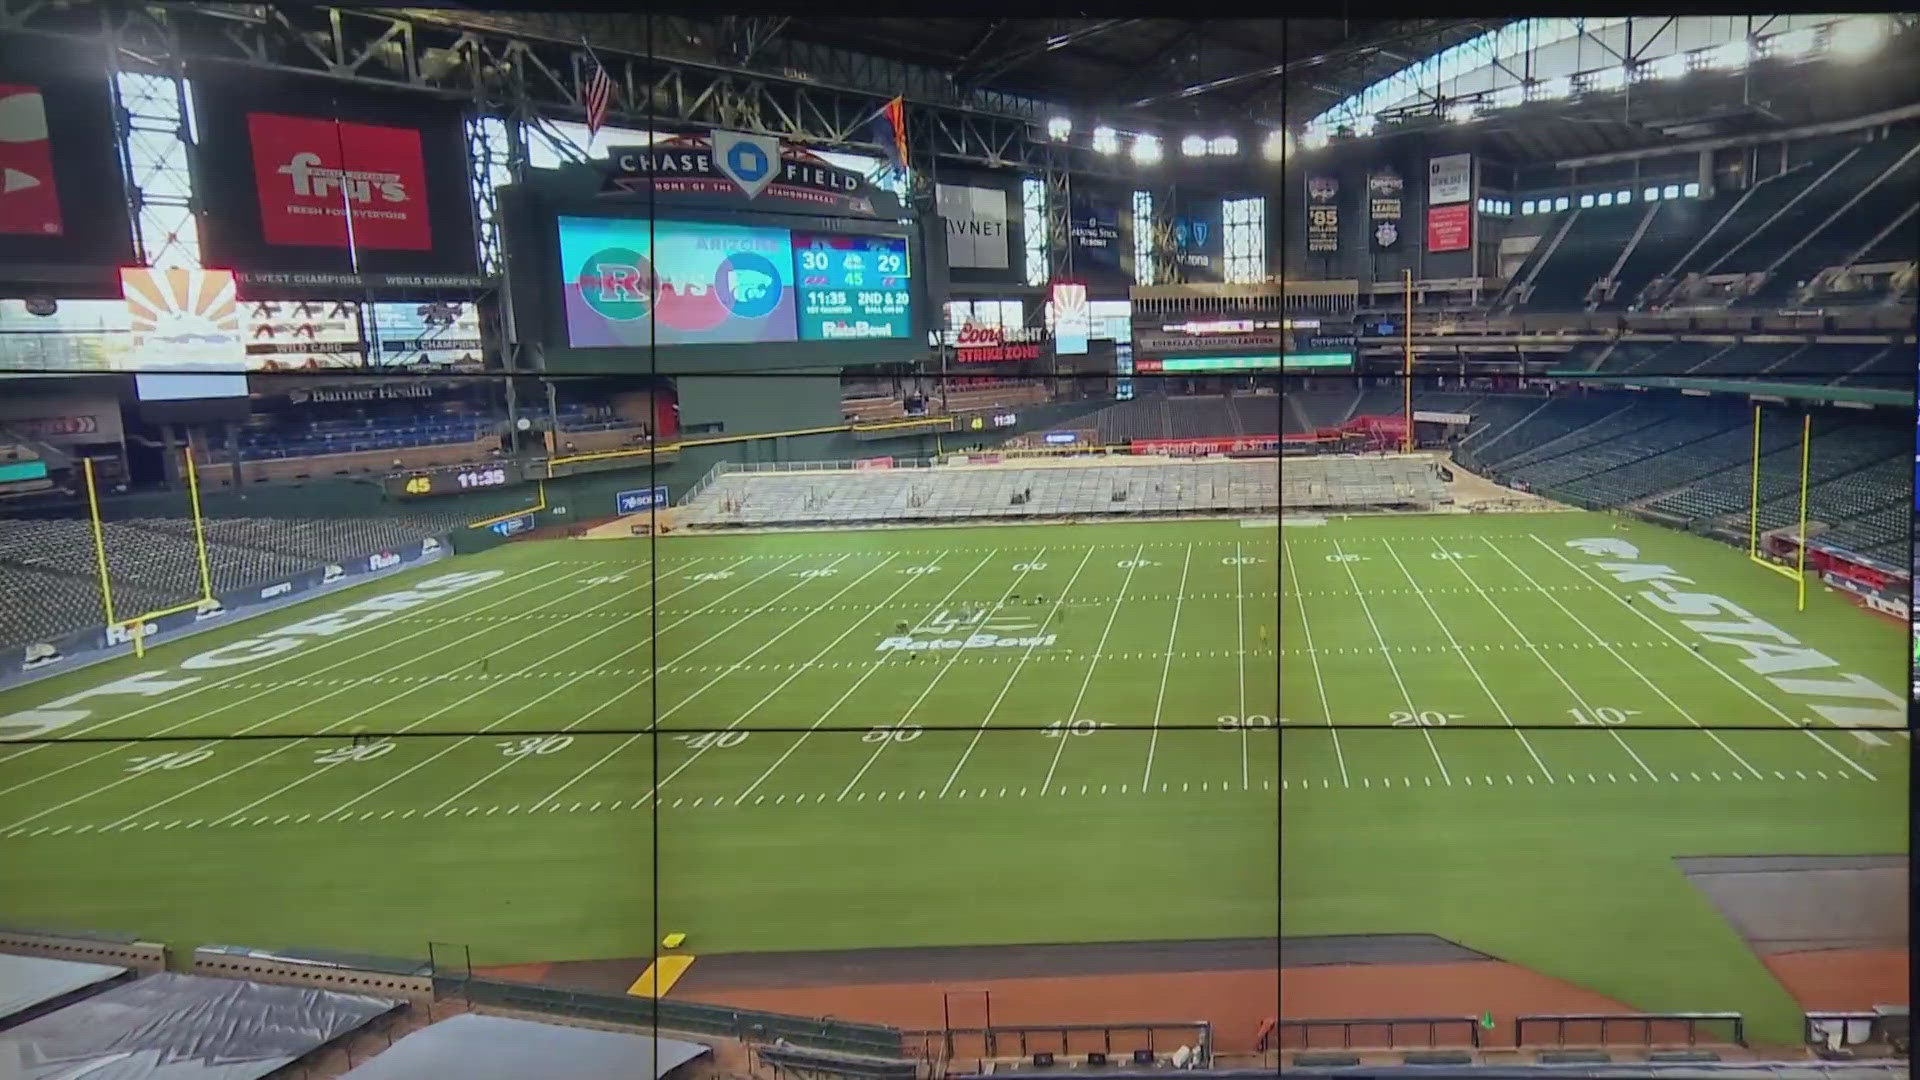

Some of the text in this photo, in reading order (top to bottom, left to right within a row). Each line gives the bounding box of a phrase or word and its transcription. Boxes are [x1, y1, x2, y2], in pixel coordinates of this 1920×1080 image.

[277, 152, 411, 203] fry's
[619, 154, 859, 191] CHASE FIELD
[655, 182, 685, 191] HOME
[692, 183, 705, 191] OF
[714, 183, 732, 192] THE
[287, 205, 322, 215] FRESH
[948, 220, 1002, 237] AVNET
[802, 251, 829, 271] 30
[877, 254, 901, 273] 29
[256, 273, 291, 285] WEST
[294, 274, 363, 285] CHAMPIONS
[386, 276, 482, 287] WORLD CHAMPIONS
[844, 272, 863, 286] 45
[807, 291, 847, 305] 11:35
[858, 291, 884, 306] 2ND
[958, 322, 1004, 344] Coors
[275, 343, 343, 353] WILD CARD
[421, 339, 483, 350] CHAMPIONS
[958, 345, 1041, 363] STRIKE ZONE
[313, 385, 433, 403] Banner Health
[406, 469, 506, 495] 45 11:35
[106, 622, 158, 646] Rae
[875, 634, 1058, 651] RateBowl
[1217, 714, 1271, 733] 30
[1388, 710, 1448, 728] 20
[1566, 706, 1627, 726] 10
[862, 724, 924, 743] 50
[1040, 719, 1104, 738] 40
[685, 730, 751, 750] 40
